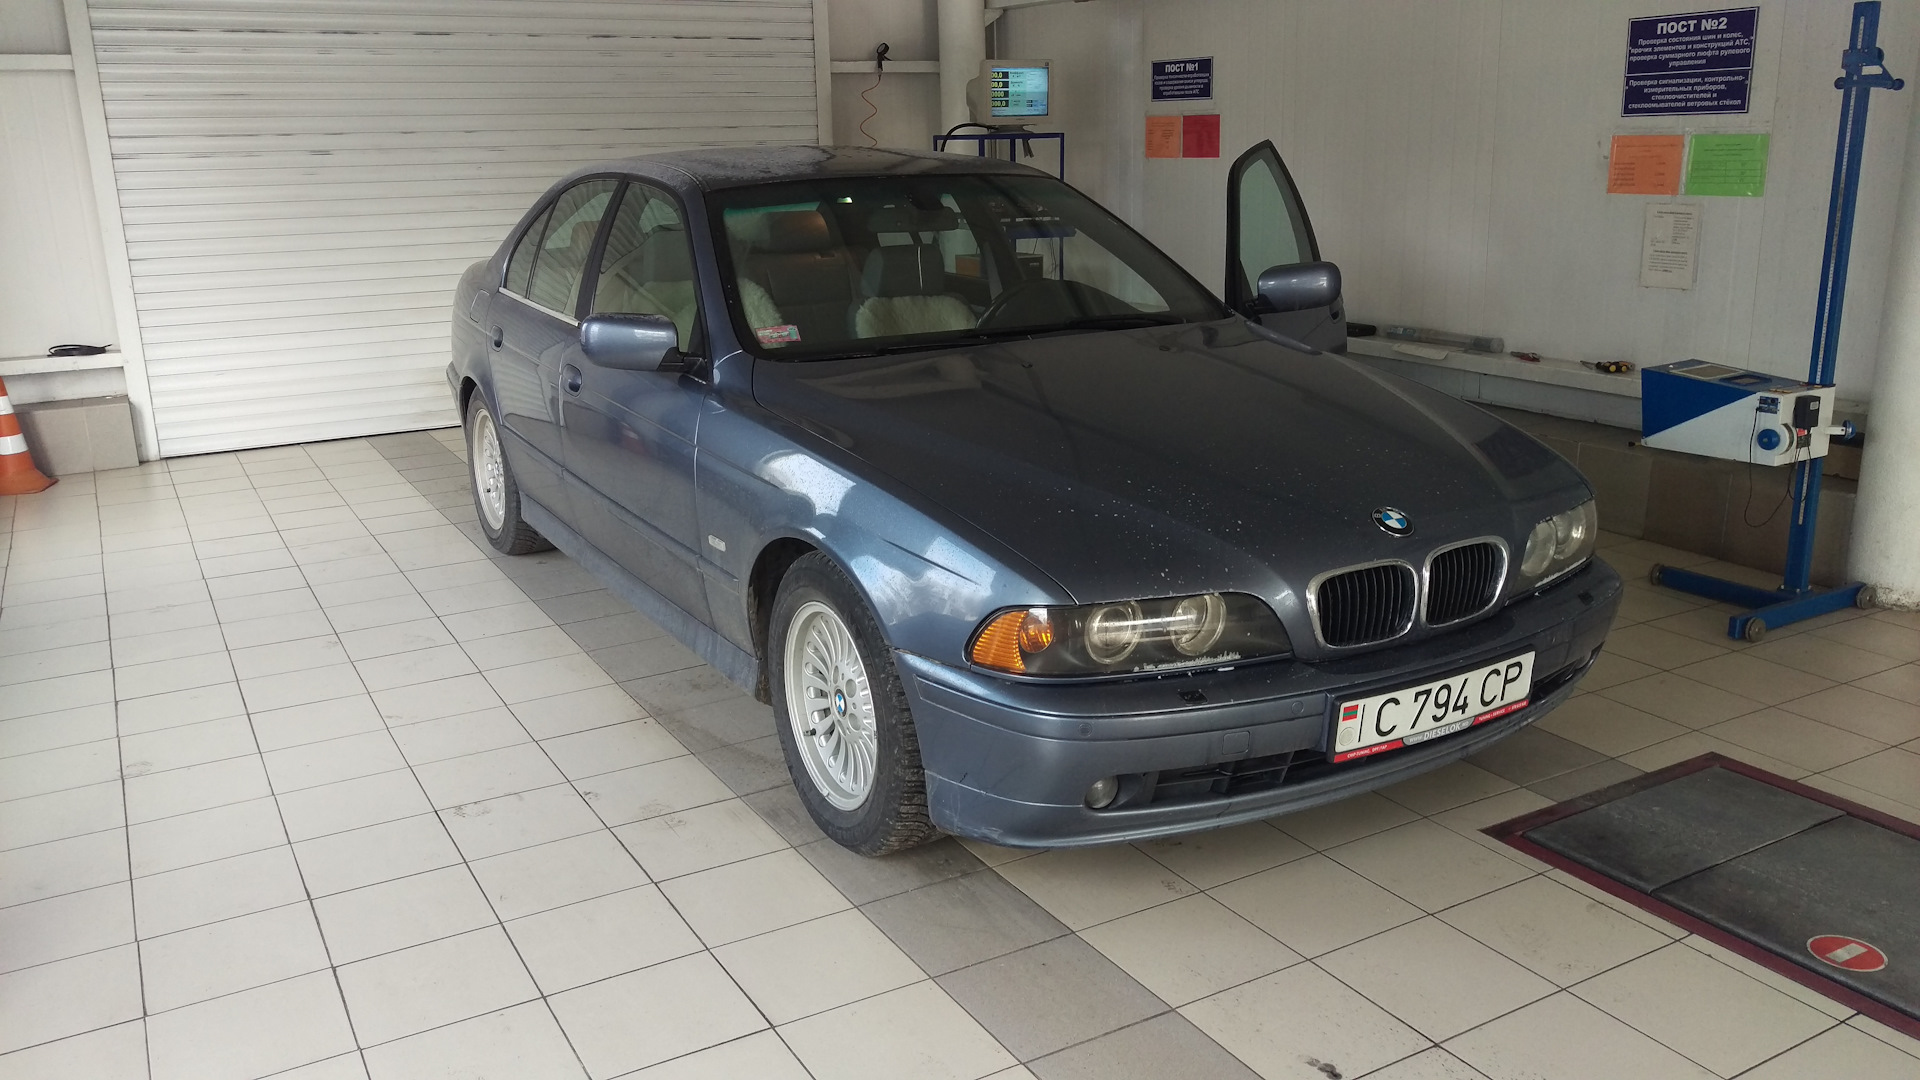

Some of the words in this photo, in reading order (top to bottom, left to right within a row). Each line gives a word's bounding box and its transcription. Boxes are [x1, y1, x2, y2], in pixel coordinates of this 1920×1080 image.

[1657, 20, 1697, 34] ПОСТ
[1701, 18, 1728, 30] №2
[1638, 37, 1668, 46] Проверка
[1668, 35, 1702, 43] состояния
[1631, 46, 1652, 54] прочих
[1653, 44, 1686, 52] элементов
[1693, 40, 1734, 50] конструкций
[1629, 52, 1658, 62] проверка
[1658, 50, 1696, 60] суммарного
[1696, 49, 1719, 58] люфта
[1720, 47, 1751, 56] рулевого
[1165, 64, 1184, 72] ПОСТ
[1186, 63, 1198, 71] №1
[1668, 58, 1707, 68] управления
[1629, 78, 1658, 87] Проверка
[1643, 84, 1693, 94] измерительных
[1651, 92, 1711, 100] стеклоочистителей
[1628, 101, 1686, 109] стеклоомывателей
[1375, 697, 1401, 737] C
[1409, 677, 1469, 730] 794
[1479, 661, 1523, 707] CP
